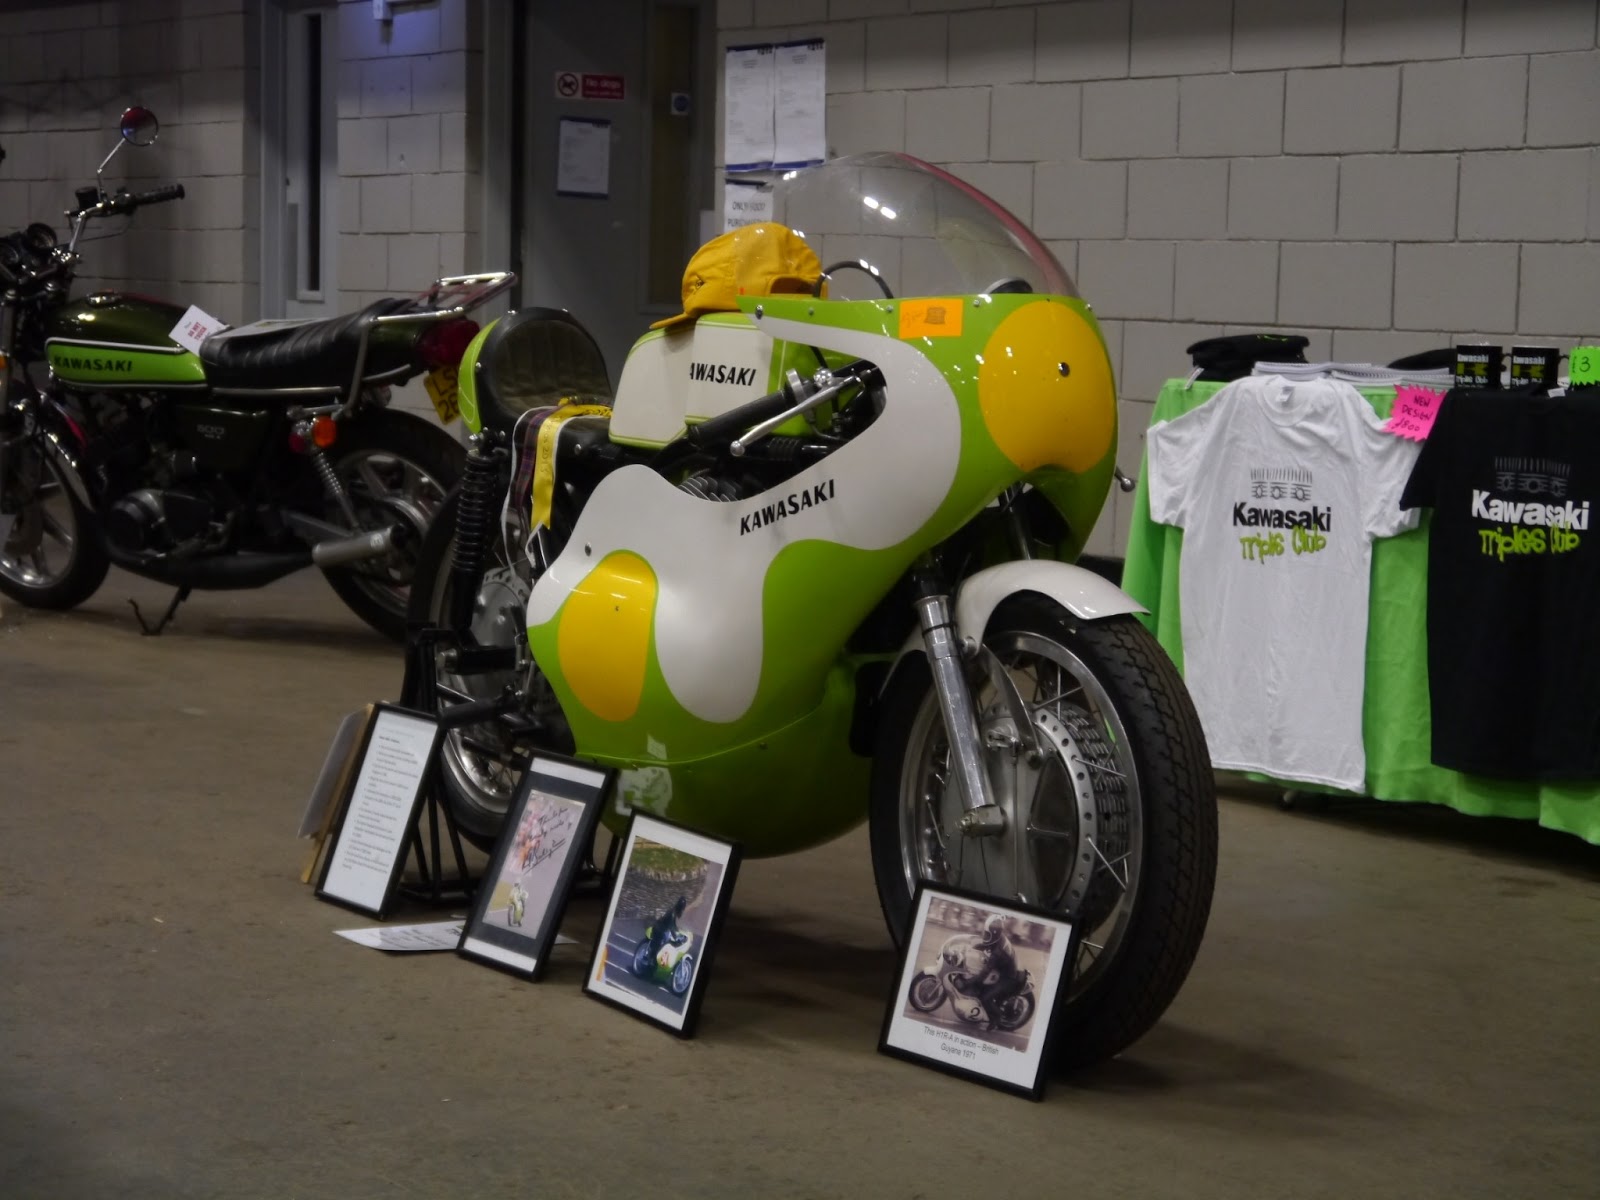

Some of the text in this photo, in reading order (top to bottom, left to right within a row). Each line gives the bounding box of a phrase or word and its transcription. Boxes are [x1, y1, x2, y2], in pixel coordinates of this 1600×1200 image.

[54, 355, 133, 372] KAWASAKI
[689, 362, 757, 386] AWASAKI
[740, 479, 835, 536] KAWASAKI
[1233, 502, 1331, 532] Kawasaki
[1471, 489, 1590, 530] Kawasaki
[1292, 524, 1327, 555] Club
[1478, 525, 1546, 562] Triples
[924, 1026, 935, 1037] This
[960, 1039, 977, 1048] action
[981, 1044, 999, 1056] British
[963, 1049, 976, 1060] 1971
